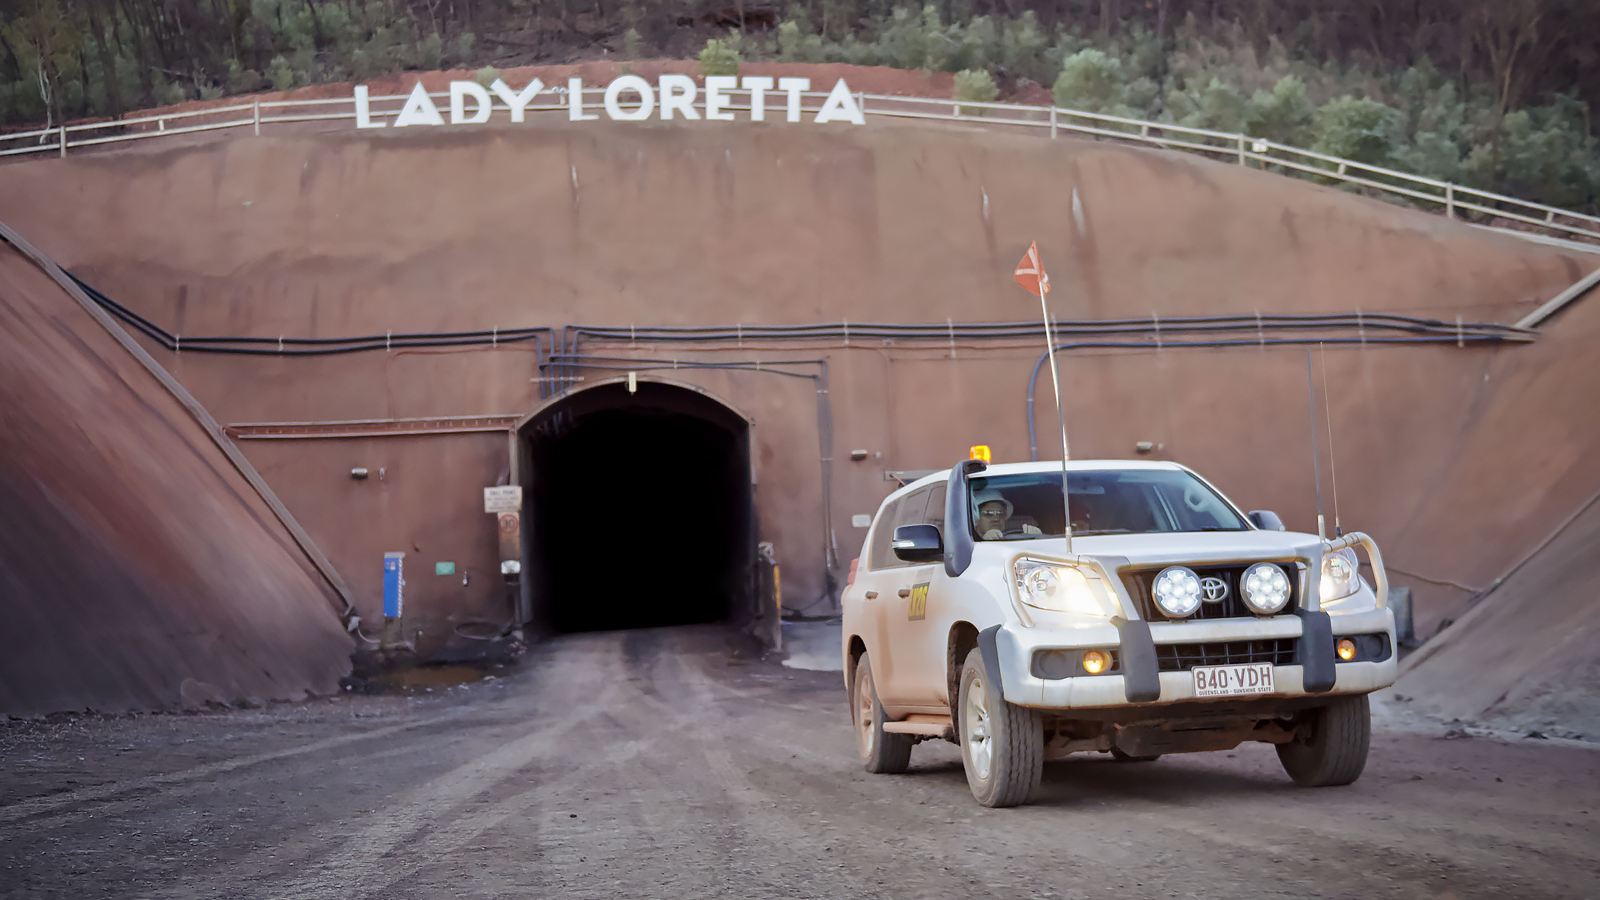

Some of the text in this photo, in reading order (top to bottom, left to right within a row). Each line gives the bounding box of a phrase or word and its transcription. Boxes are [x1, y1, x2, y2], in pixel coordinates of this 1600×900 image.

[356, 74, 866, 129] LADY LORETTA
[502, 518, 515, 529] 30
